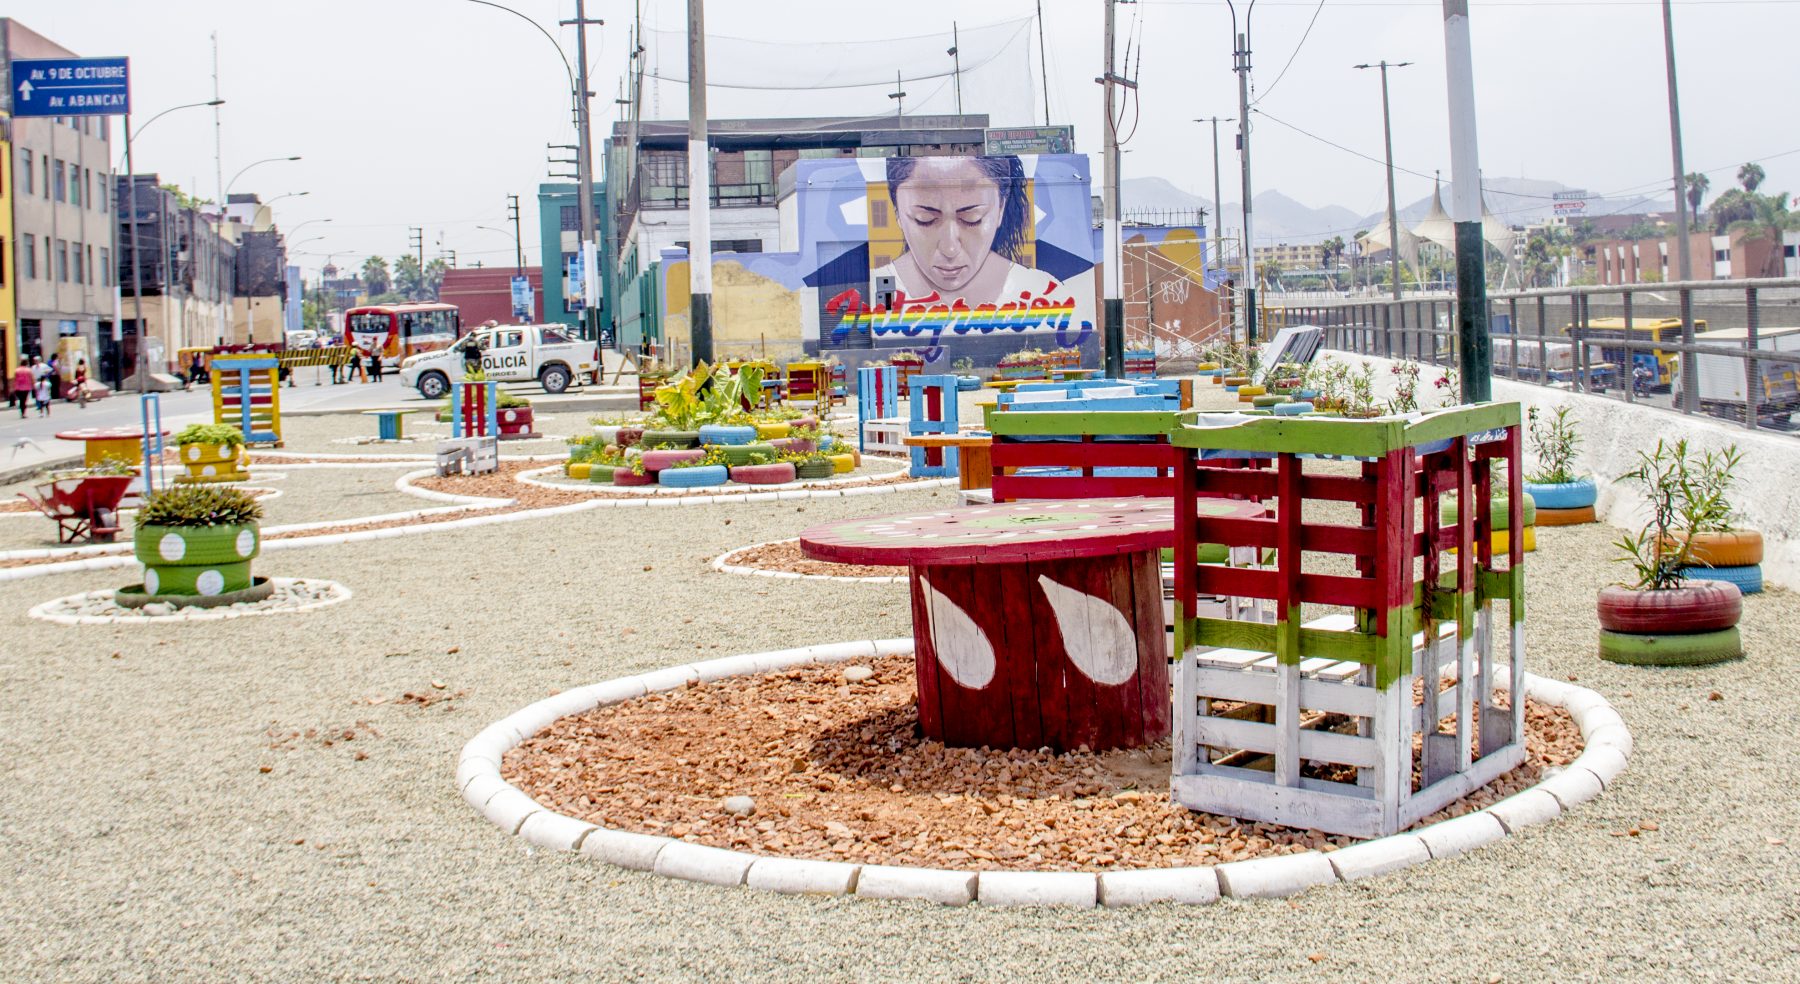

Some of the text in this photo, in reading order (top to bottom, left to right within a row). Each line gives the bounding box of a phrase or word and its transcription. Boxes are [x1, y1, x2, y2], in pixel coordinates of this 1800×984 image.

[48, 68, 57, 79] 9
[58, 68, 72, 79] DE
[74, 66, 126, 79] OCTUBRE
[68, 94, 126, 106] ABANCAY
[417, 352, 449, 363] POLICIA
[483, 355, 527, 369] OLICIA
